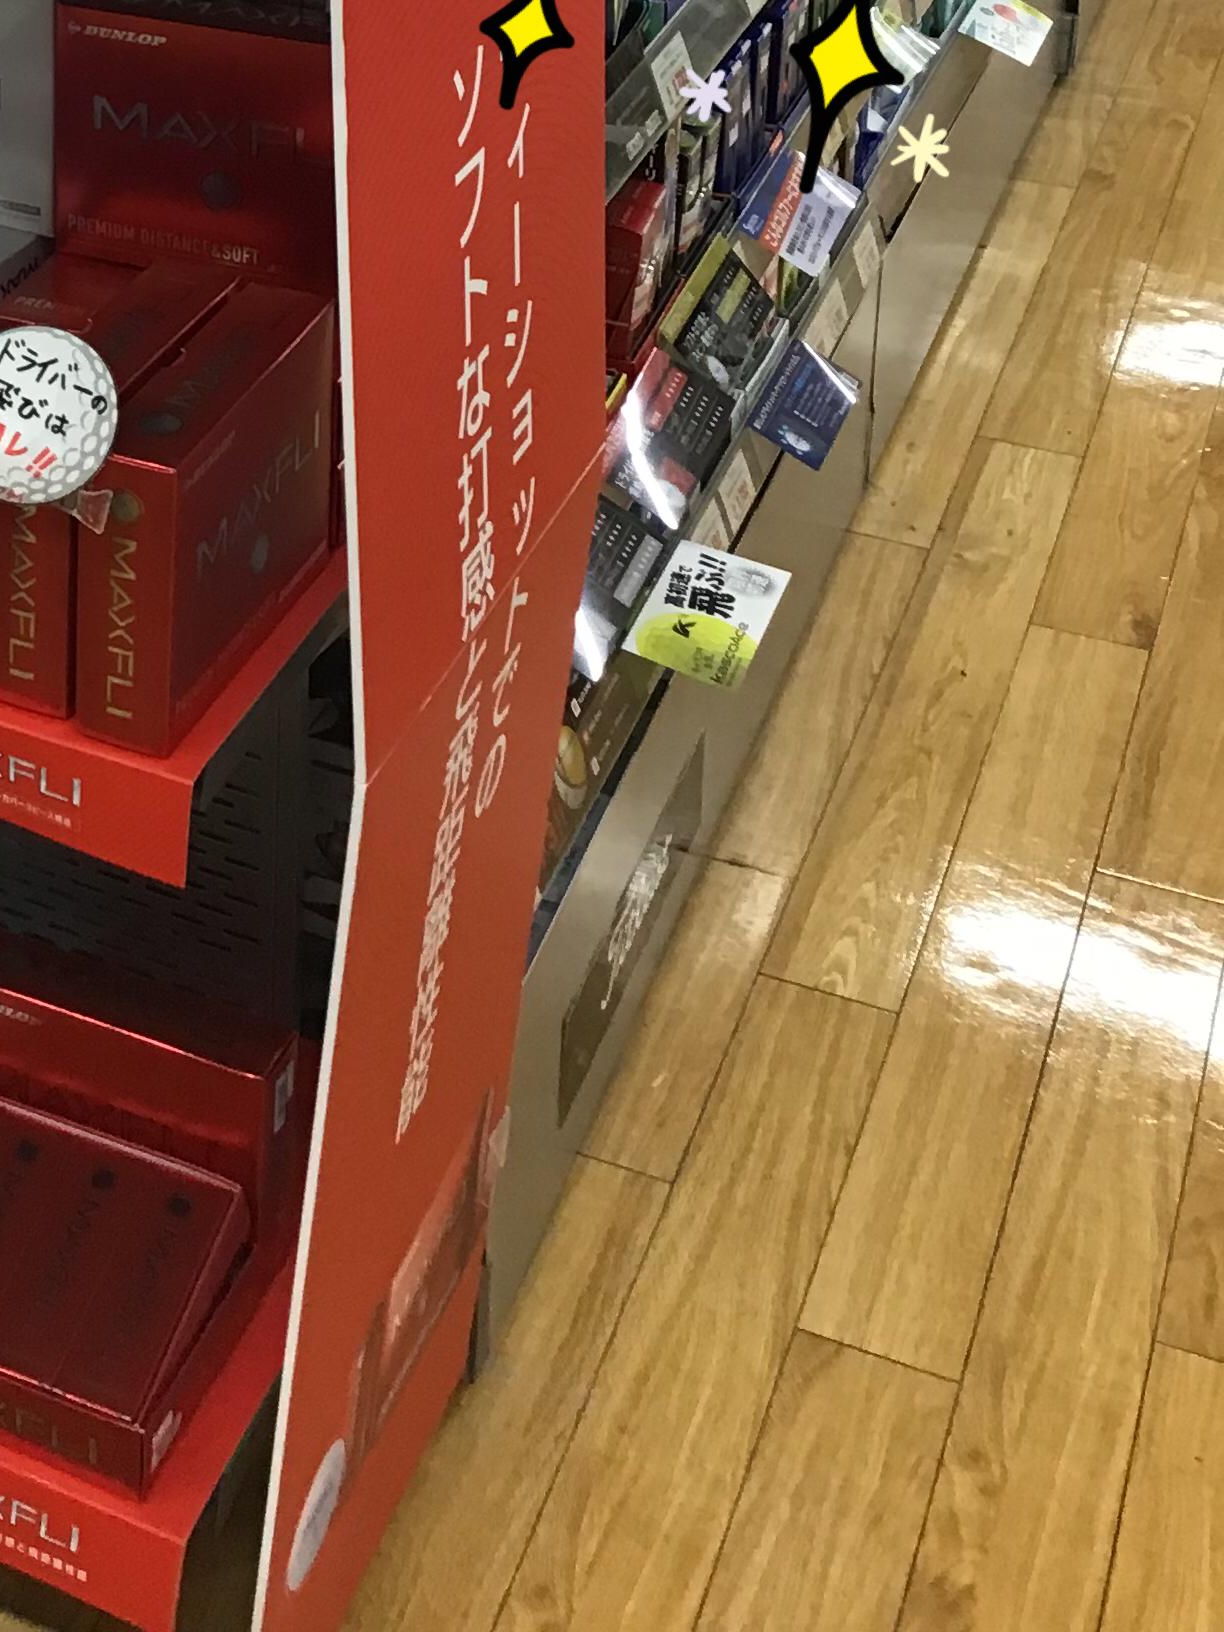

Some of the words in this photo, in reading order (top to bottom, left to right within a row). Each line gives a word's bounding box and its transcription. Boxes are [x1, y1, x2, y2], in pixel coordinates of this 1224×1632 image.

[84, 25, 167, 48] DUNLOP
[475, 101, 536, 820] ィーショットでの
[107, 537, 137, 721] MAXFLI
